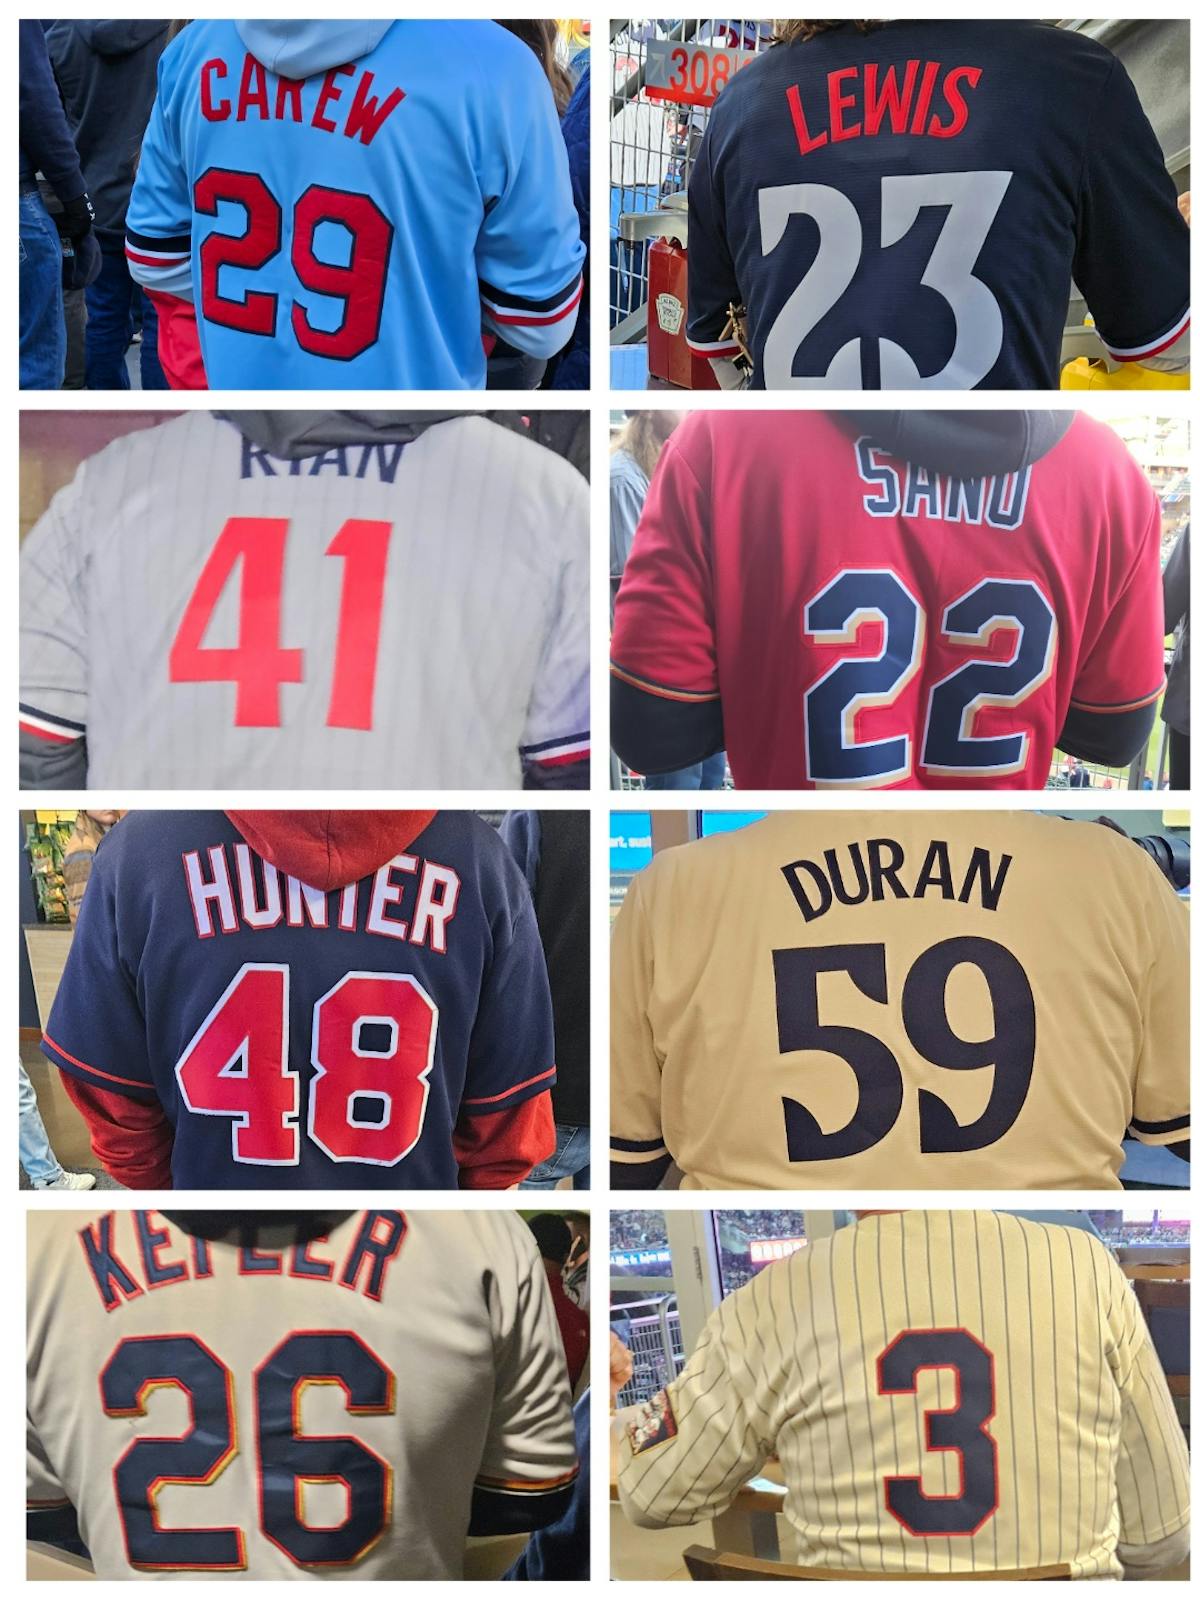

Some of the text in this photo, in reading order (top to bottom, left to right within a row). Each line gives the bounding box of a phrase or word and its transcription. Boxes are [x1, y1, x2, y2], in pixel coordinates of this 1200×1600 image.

[201, 52, 407, 146] CAREW
[669, 48, 730, 98] 308
[786, 59, 983, 155] LEWIS
[193, 166, 394, 361] 29
[758, 170, 1014, 390] 23
[241, 436, 405, 483] RAN
[168, 516, 393, 731] 41
[803, 566, 1058, 790] 22
[780, 838, 1013, 923] DURAN
[173, 962, 440, 1167] 48
[772, 935, 1037, 1162] 59
[99, 1329, 396, 1570] 26
[875, 1326, 1001, 1537] 3
